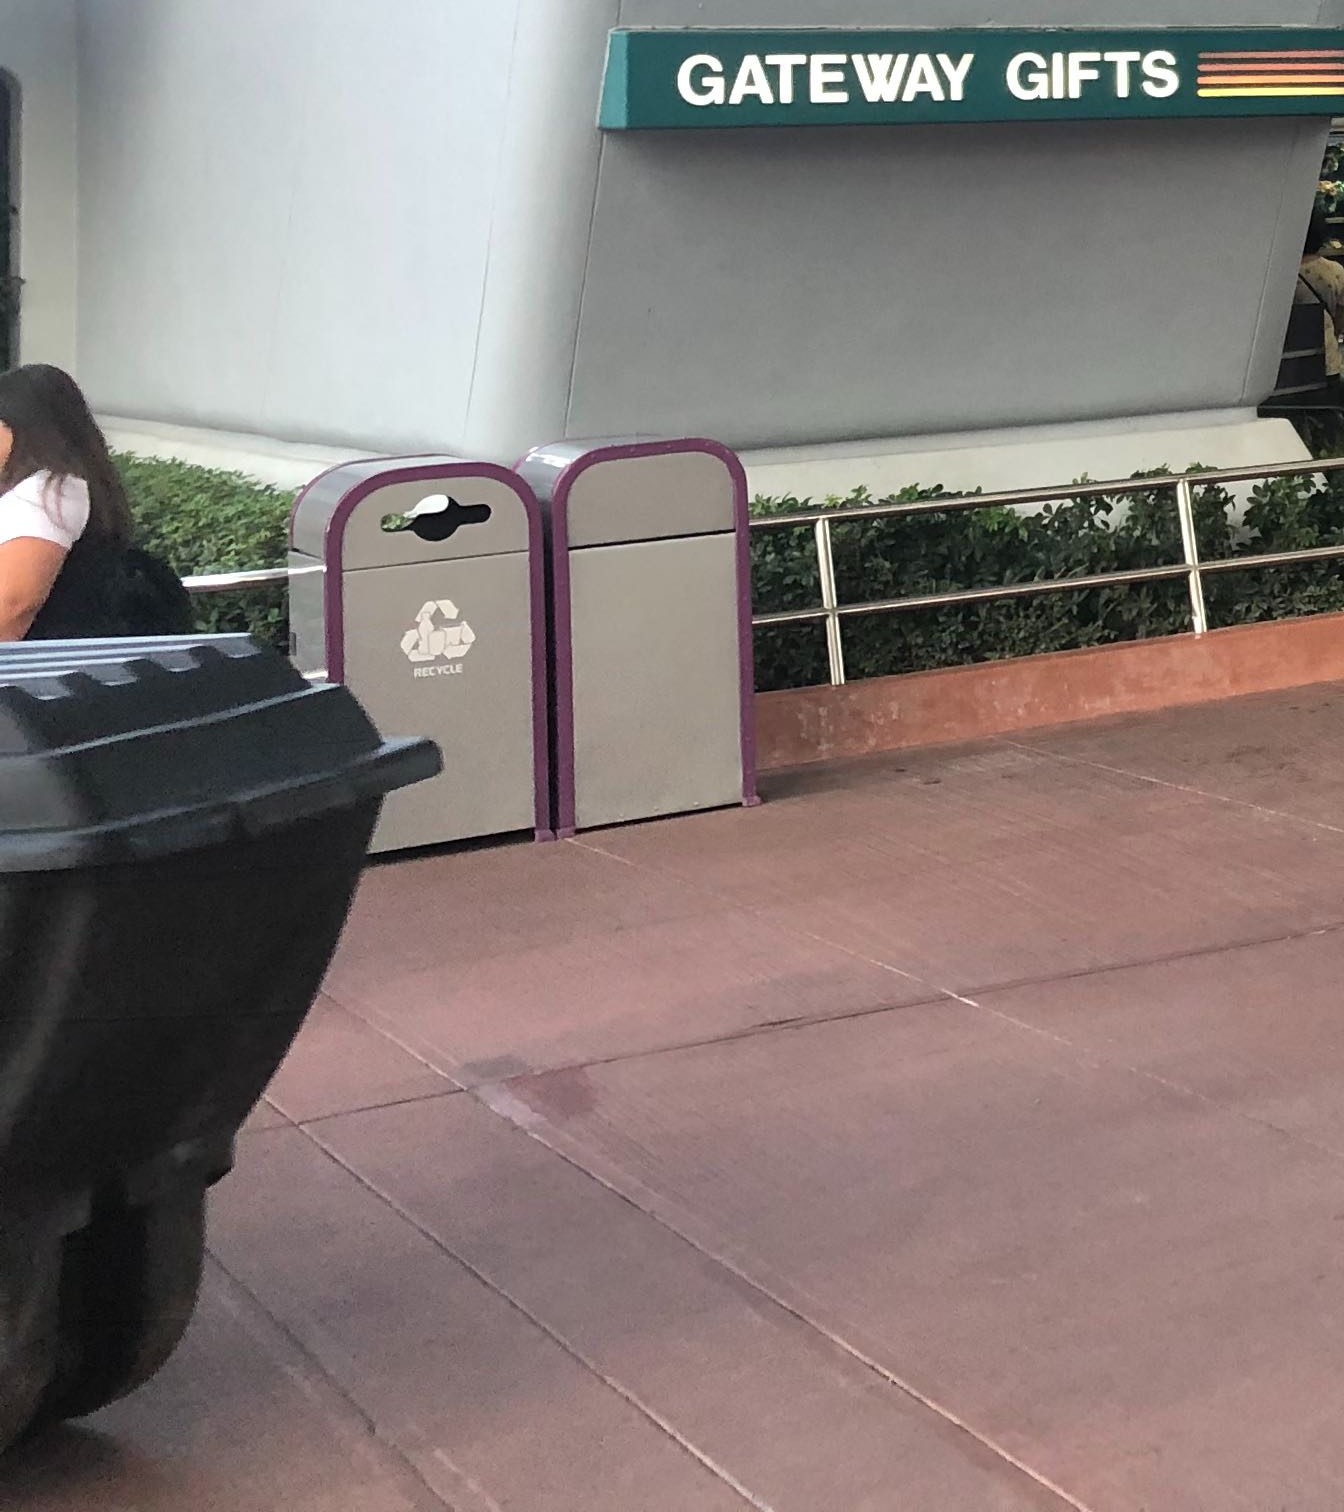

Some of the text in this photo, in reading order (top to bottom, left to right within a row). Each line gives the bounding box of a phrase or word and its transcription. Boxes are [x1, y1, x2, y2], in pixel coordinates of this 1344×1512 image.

[677, 50, 1180, 106] GATEWAY GIFTS
[413, 663, 463, 678] RECYCLE
